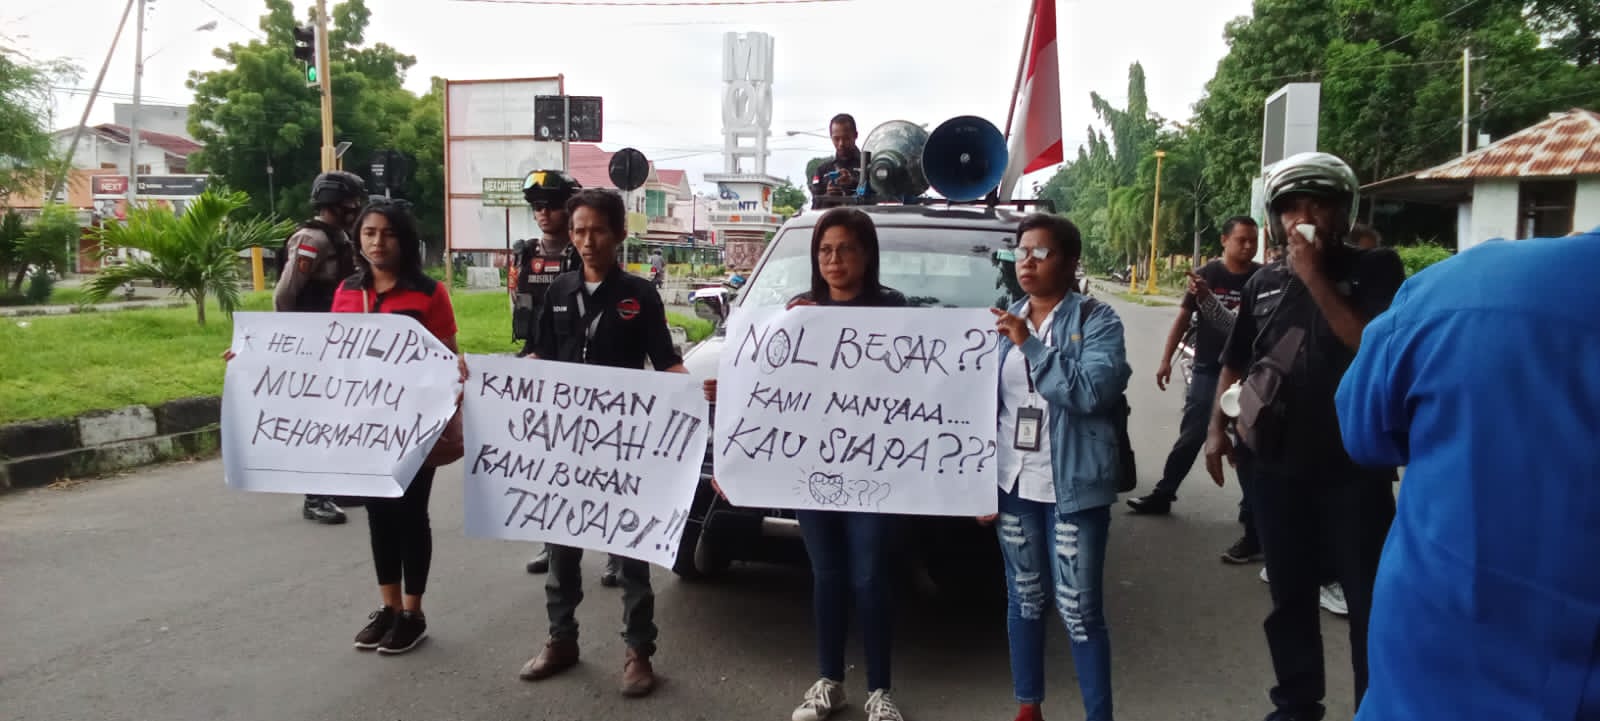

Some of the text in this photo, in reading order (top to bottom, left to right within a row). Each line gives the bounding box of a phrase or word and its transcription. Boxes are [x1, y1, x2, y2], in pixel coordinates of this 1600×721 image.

[734, 323, 818, 370] NOL
[253, 364, 405, 411] MULUTMU
[480, 372, 657, 416] KAMI BUKAN
[747, 381, 812, 413] KAMI
[722, 417, 808, 462] KAU
[471, 444, 642, 496] KAMI BUKAN
